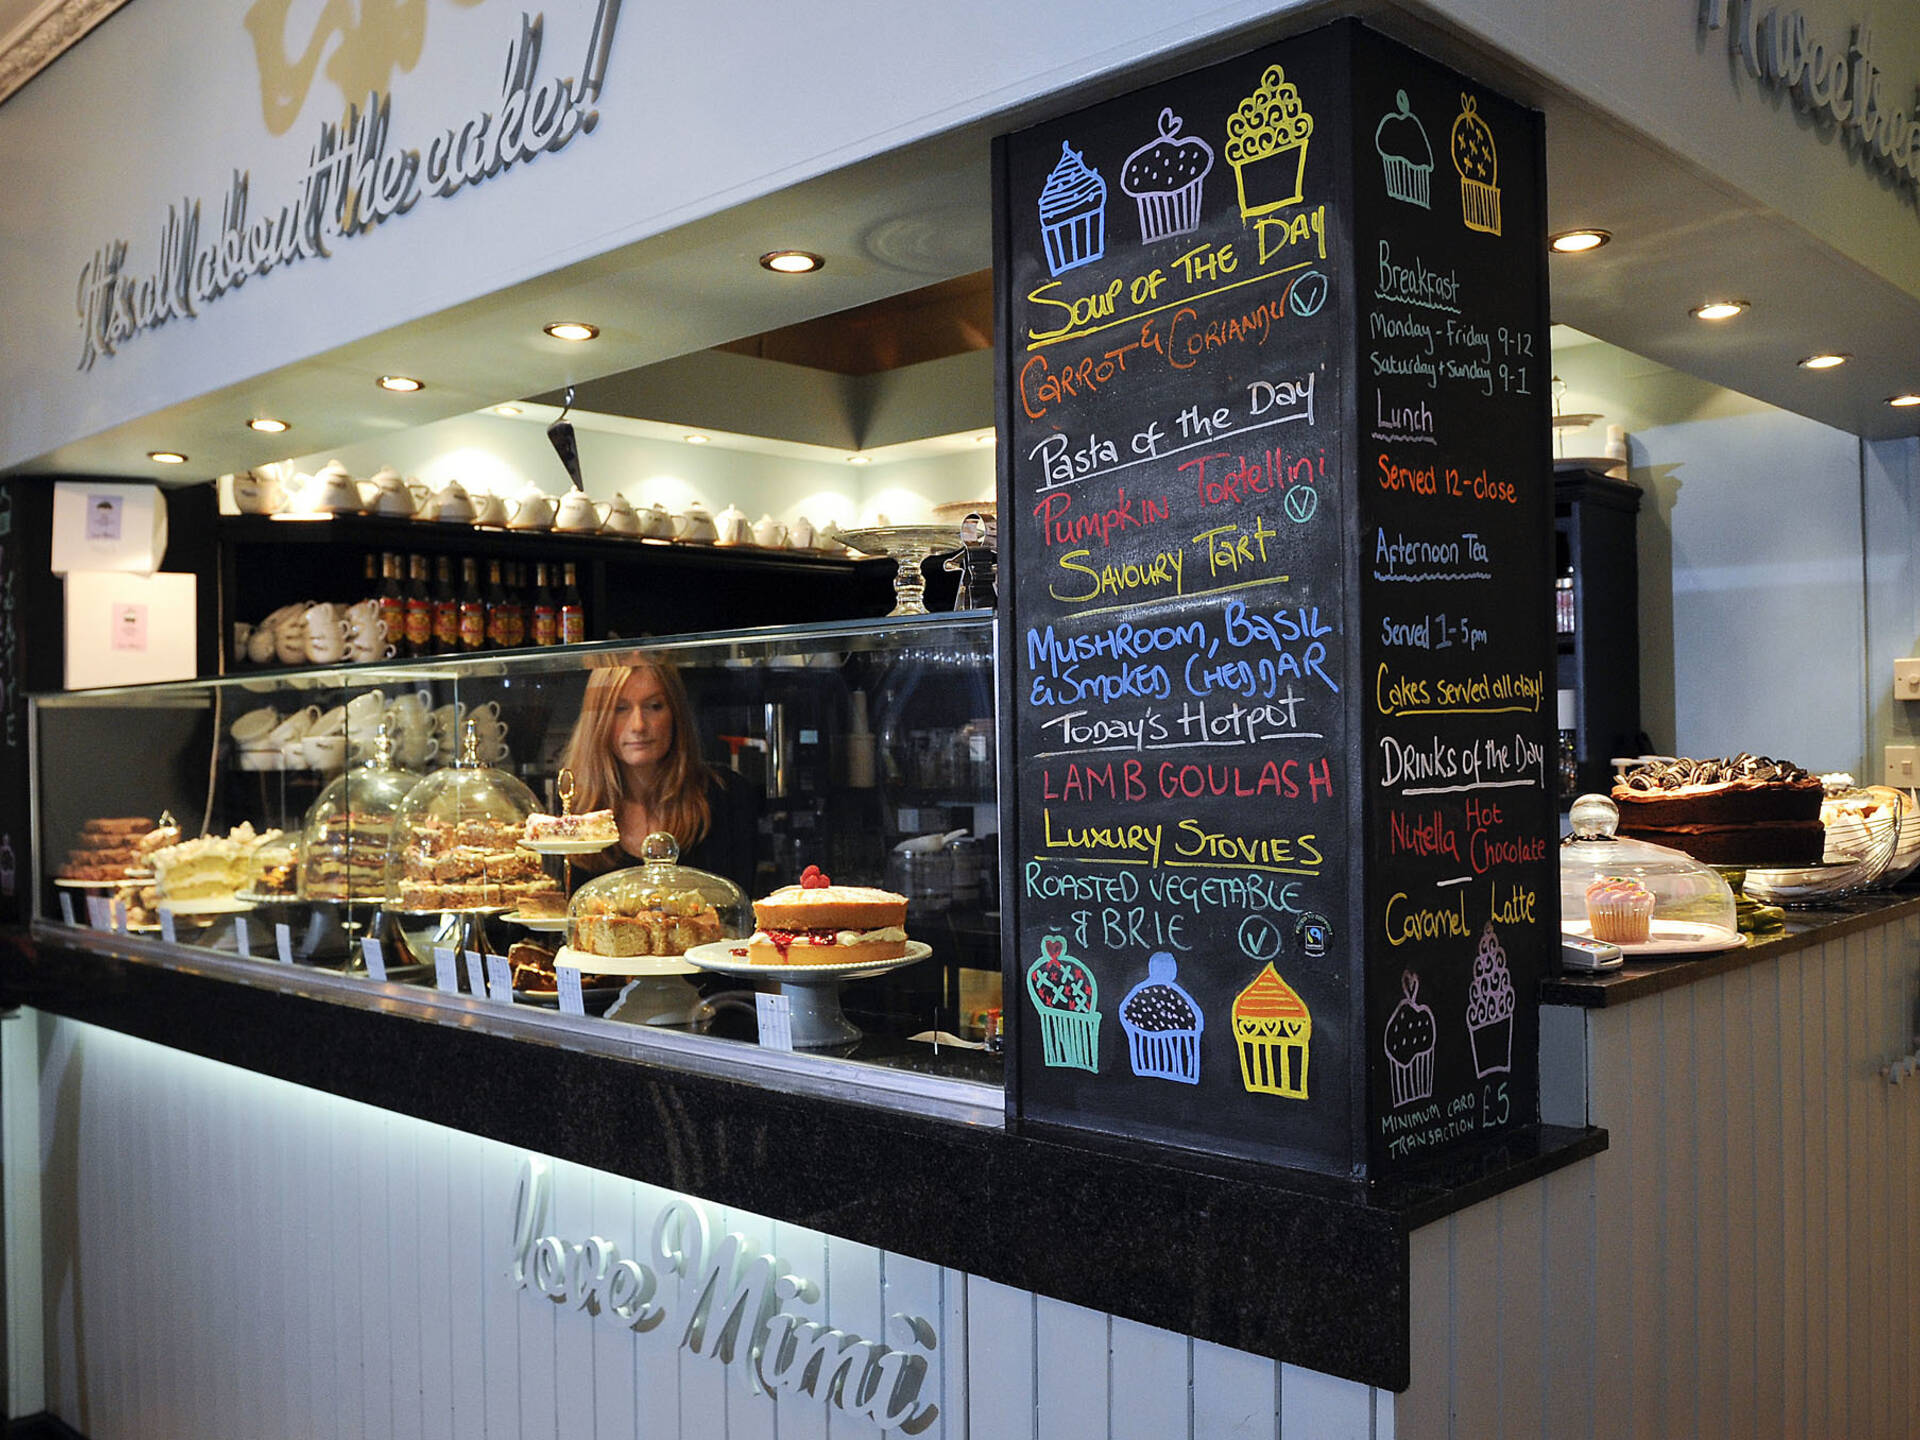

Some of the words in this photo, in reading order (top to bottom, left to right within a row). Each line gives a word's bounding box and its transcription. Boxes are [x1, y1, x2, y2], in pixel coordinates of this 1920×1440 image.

[326, 90, 422, 240] the
[1131, 269, 1166, 304] OF
[1172, 243, 1238, 283] THE
[1254, 205, 1327, 265] DAY
[1379, 240, 1460, 303] Breakfast
[1448, 359, 1493, 396] Sunday
[1029, 433, 1118, 488] Pasta
[1132, 422, 1165, 457] of
[1176, 405, 1232, 437] the
[1247, 372, 1315, 425] Day
[1377, 388, 1434, 432] Lunch
[1378, 454, 1436, 495] Served
[1376, 527, 1459, 573] Afternoon
[1462, 533, 1489, 563] Tea
[1381, 615, 1430, 649] Served
[1176, 684, 1306, 743] Hotpot
[1377, 662, 1431, 714] Cakes
[1436, 674, 1490, 705] served
[1493, 674, 1513, 699] all
[1515, 671, 1545, 712] day!
[1044, 759, 1147, 800] LAMB
[1158, 758, 1333, 803] GOULASH
[1463, 739, 1482, 783] of
[1485, 739, 1511, 773] the
[1516, 734, 1545, 789] Day
[1175, 819, 1323, 864] STOVIES
[1391, 810, 1460, 862] Nutella
[1466, 798, 1503, 831] Hot
[1470, 828, 1546, 874] Chocolate
[1025, 861, 1139, 903] ROASTED
[1150, 872, 1304, 914] VEGETABLE
[1386, 889, 1470, 945] Caramel
[1492, 881, 1535, 923] Latte
[1102, 907, 1192, 950] BRIE
[1382, 1104, 1440, 1135] MINIMUM
[1447, 1093, 1475, 1117] CARD
[1483, 1082, 1510, 1128] £5
[1389, 1117, 1475, 1160] TRANSACTION
[652, 1199, 938, 1434] Mimi
